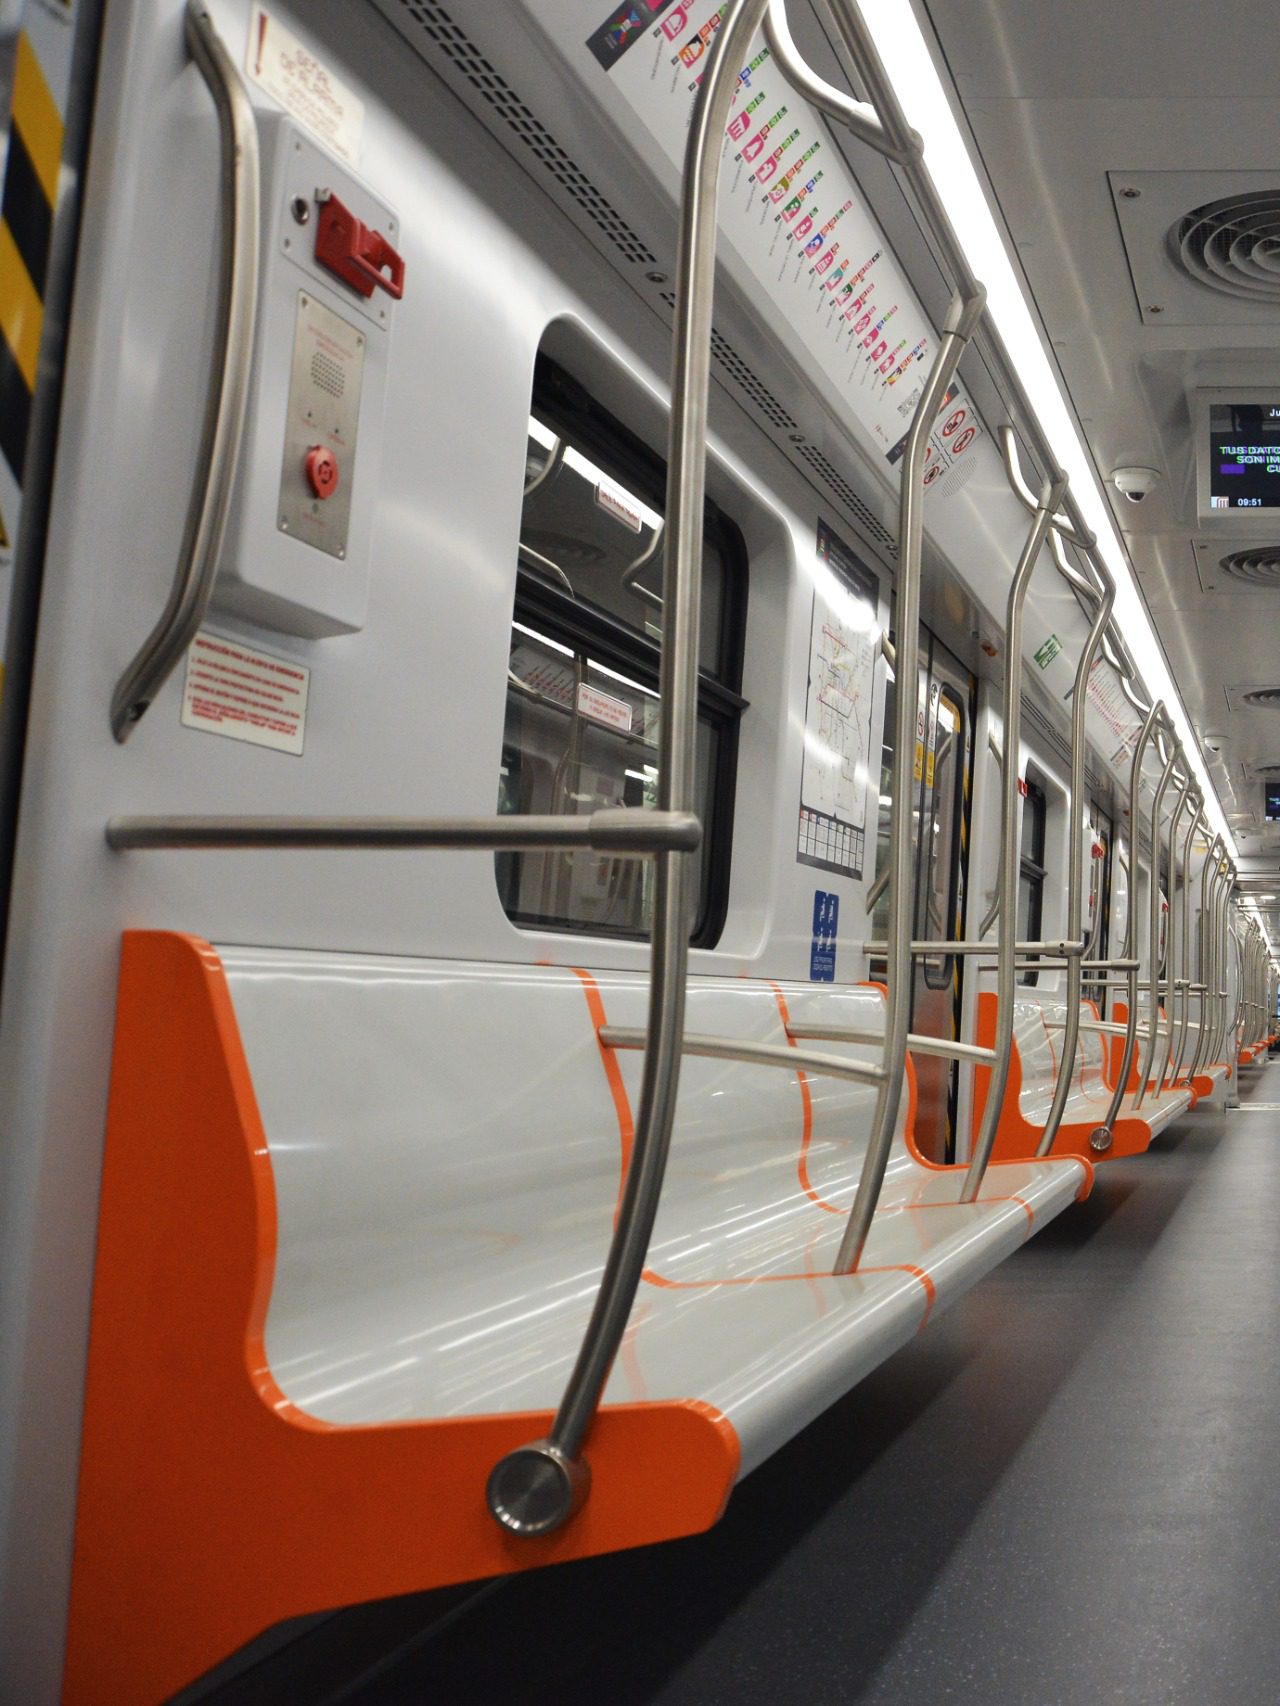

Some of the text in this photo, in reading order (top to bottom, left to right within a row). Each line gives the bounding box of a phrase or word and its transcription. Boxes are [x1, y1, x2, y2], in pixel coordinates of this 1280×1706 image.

[1219, 446, 1245, 455] TUS
[1236, 455, 1264, 464] SON
[1237, 498, 1262, 506] 09:51
